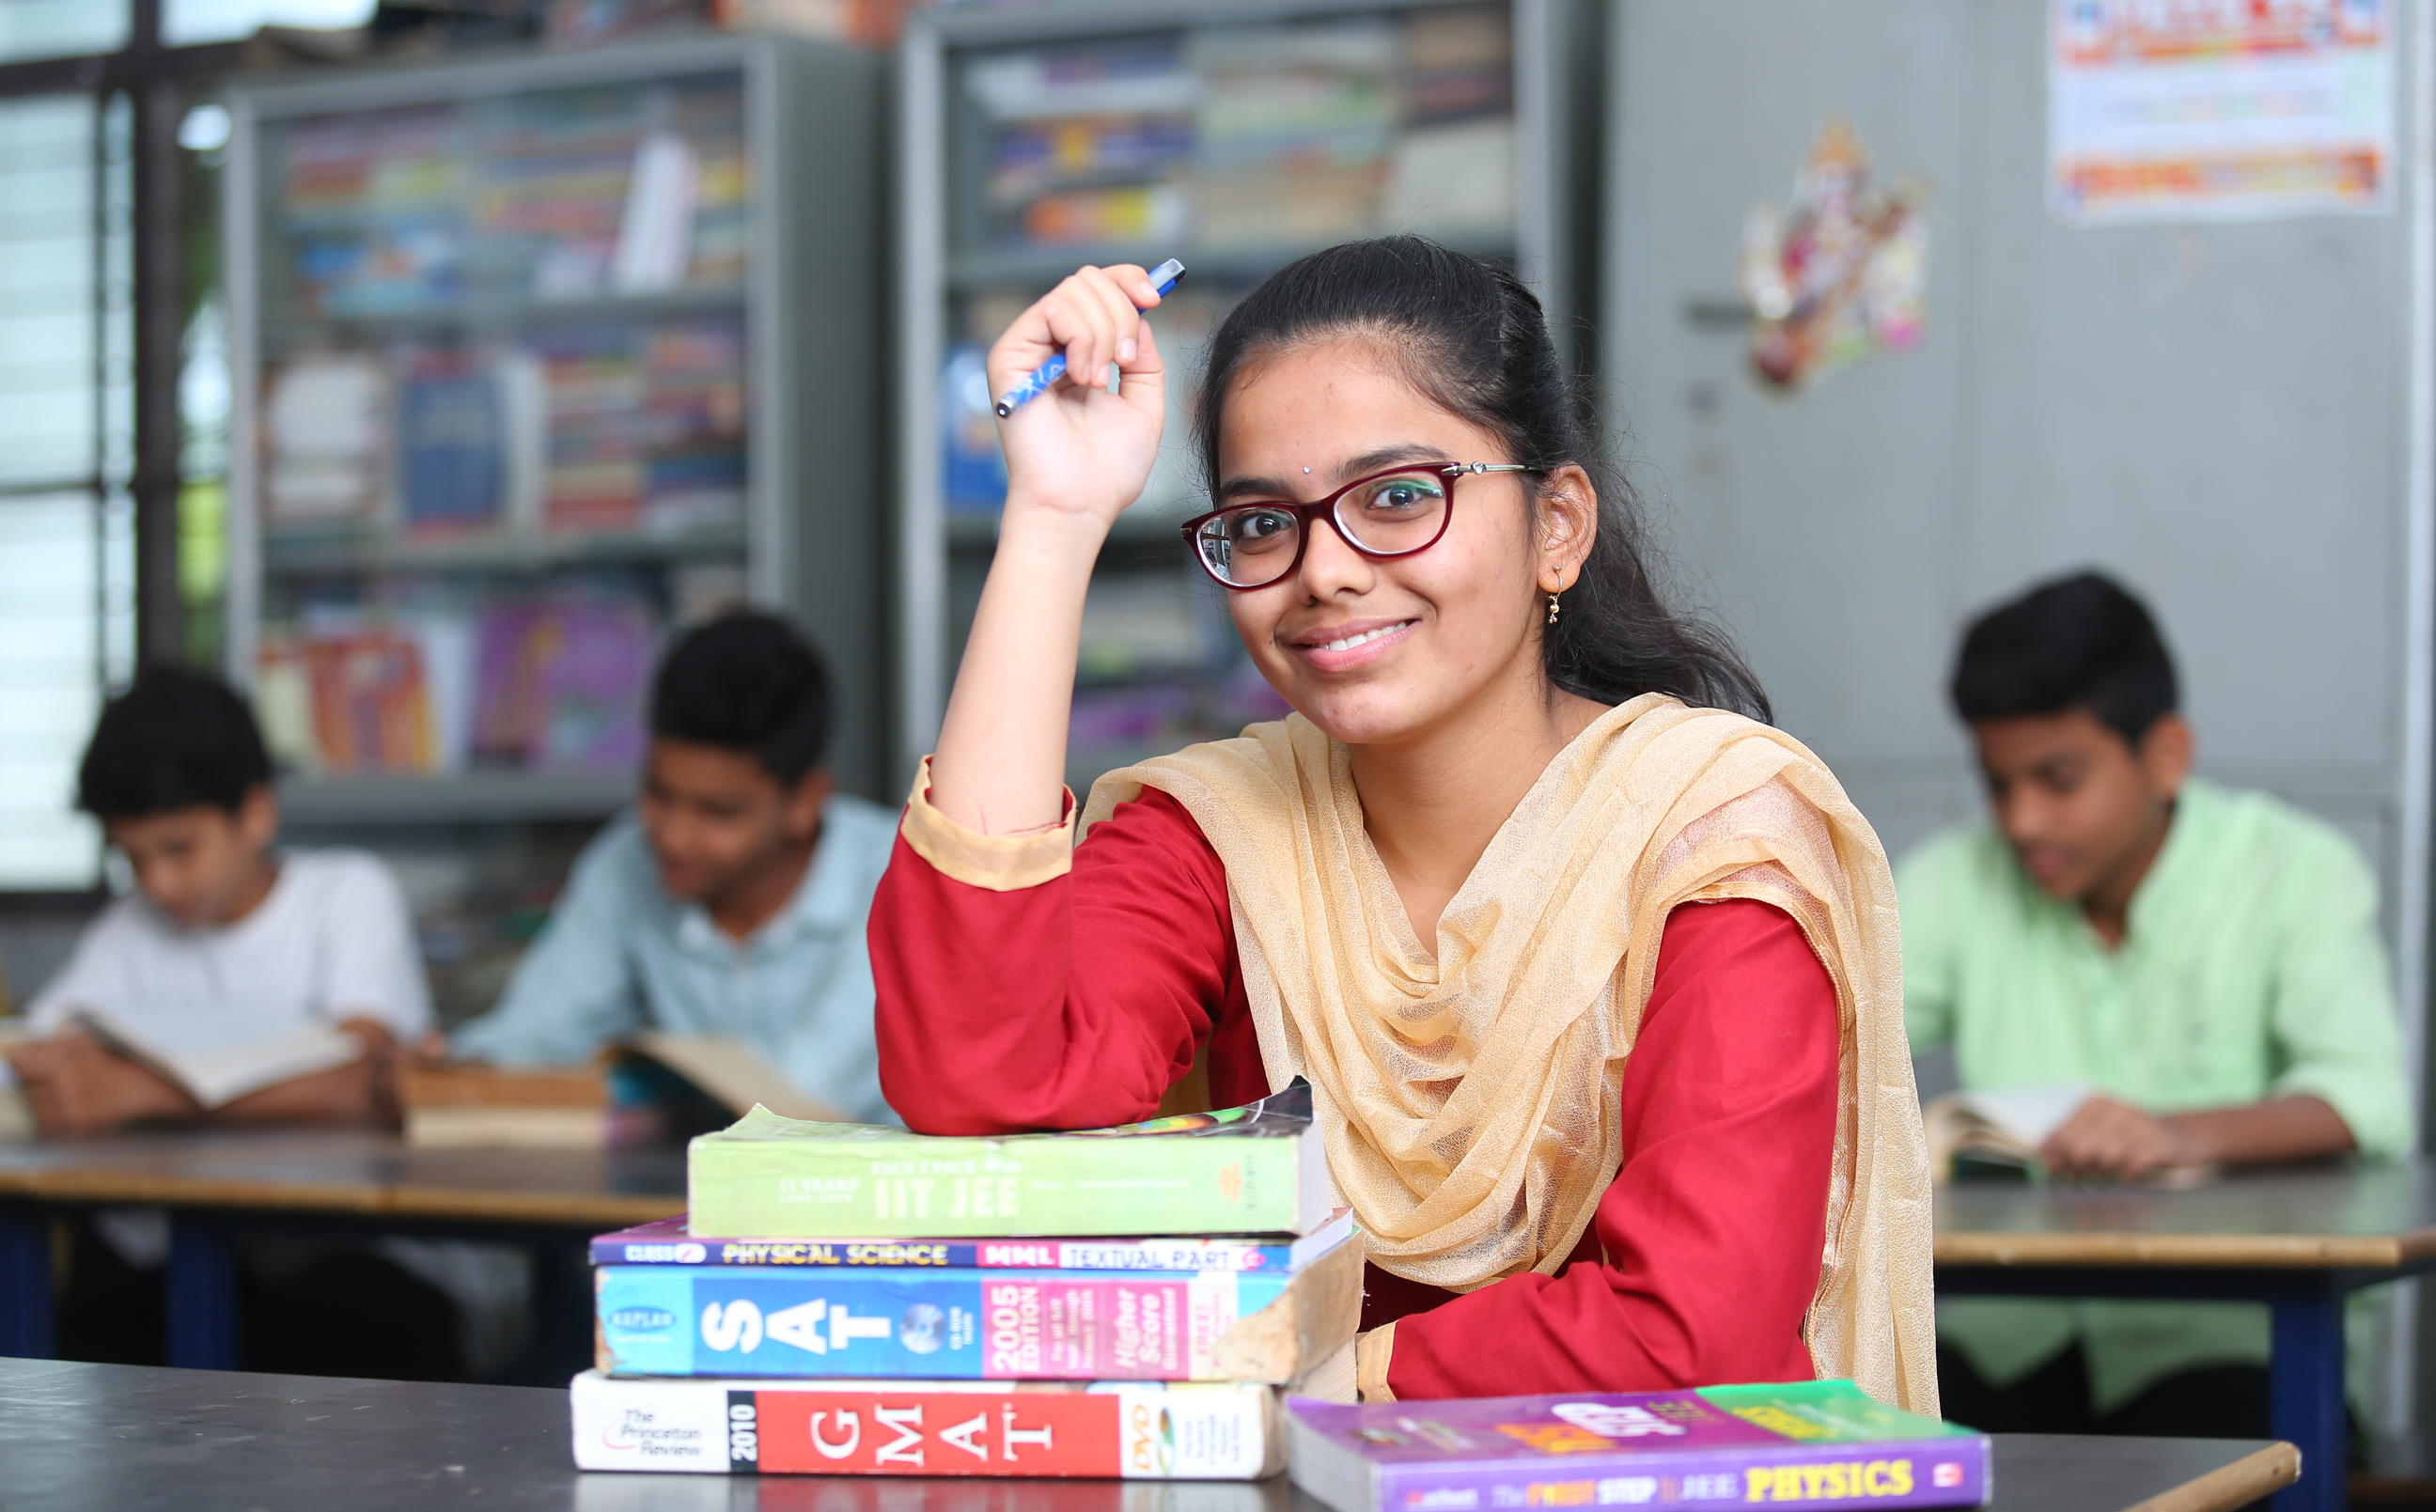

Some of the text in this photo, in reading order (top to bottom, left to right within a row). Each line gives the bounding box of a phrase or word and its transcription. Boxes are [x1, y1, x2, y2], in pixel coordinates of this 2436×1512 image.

[874, 1177, 1020, 1219] IIT JEE
[625, 1244, 675, 1262] CLASS
[722, 1243, 841, 1265] PHYSICAL
[846, 1243, 949, 1266] SCIENCE
[984, 1245, 1055, 1267] MML
[1070, 1248, 1164, 1270] TEXTUAL
[1172, 1250, 1229, 1270] PART
[701, 1298, 891, 1355] SAT
[991, 1285, 1020, 1372] 2005
[1020, 1286, 1040, 1373] EDITION
[1114, 1286, 1140, 1368] Higher
[1139, 1293, 1161, 1364] Score
[619, 1424, 703, 1440] Princeton
[624, 1409, 655, 1423] The
[729, 1404, 757, 1462] 2010
[811, 1402, 1053, 1468] GMAT
[1131, 1404, 1153, 1473] DVD
[640, 1441, 704, 1457] Review
[1681, 1473, 1741, 1502] JEE
[1743, 1458, 1914, 1504] PHYSICS
